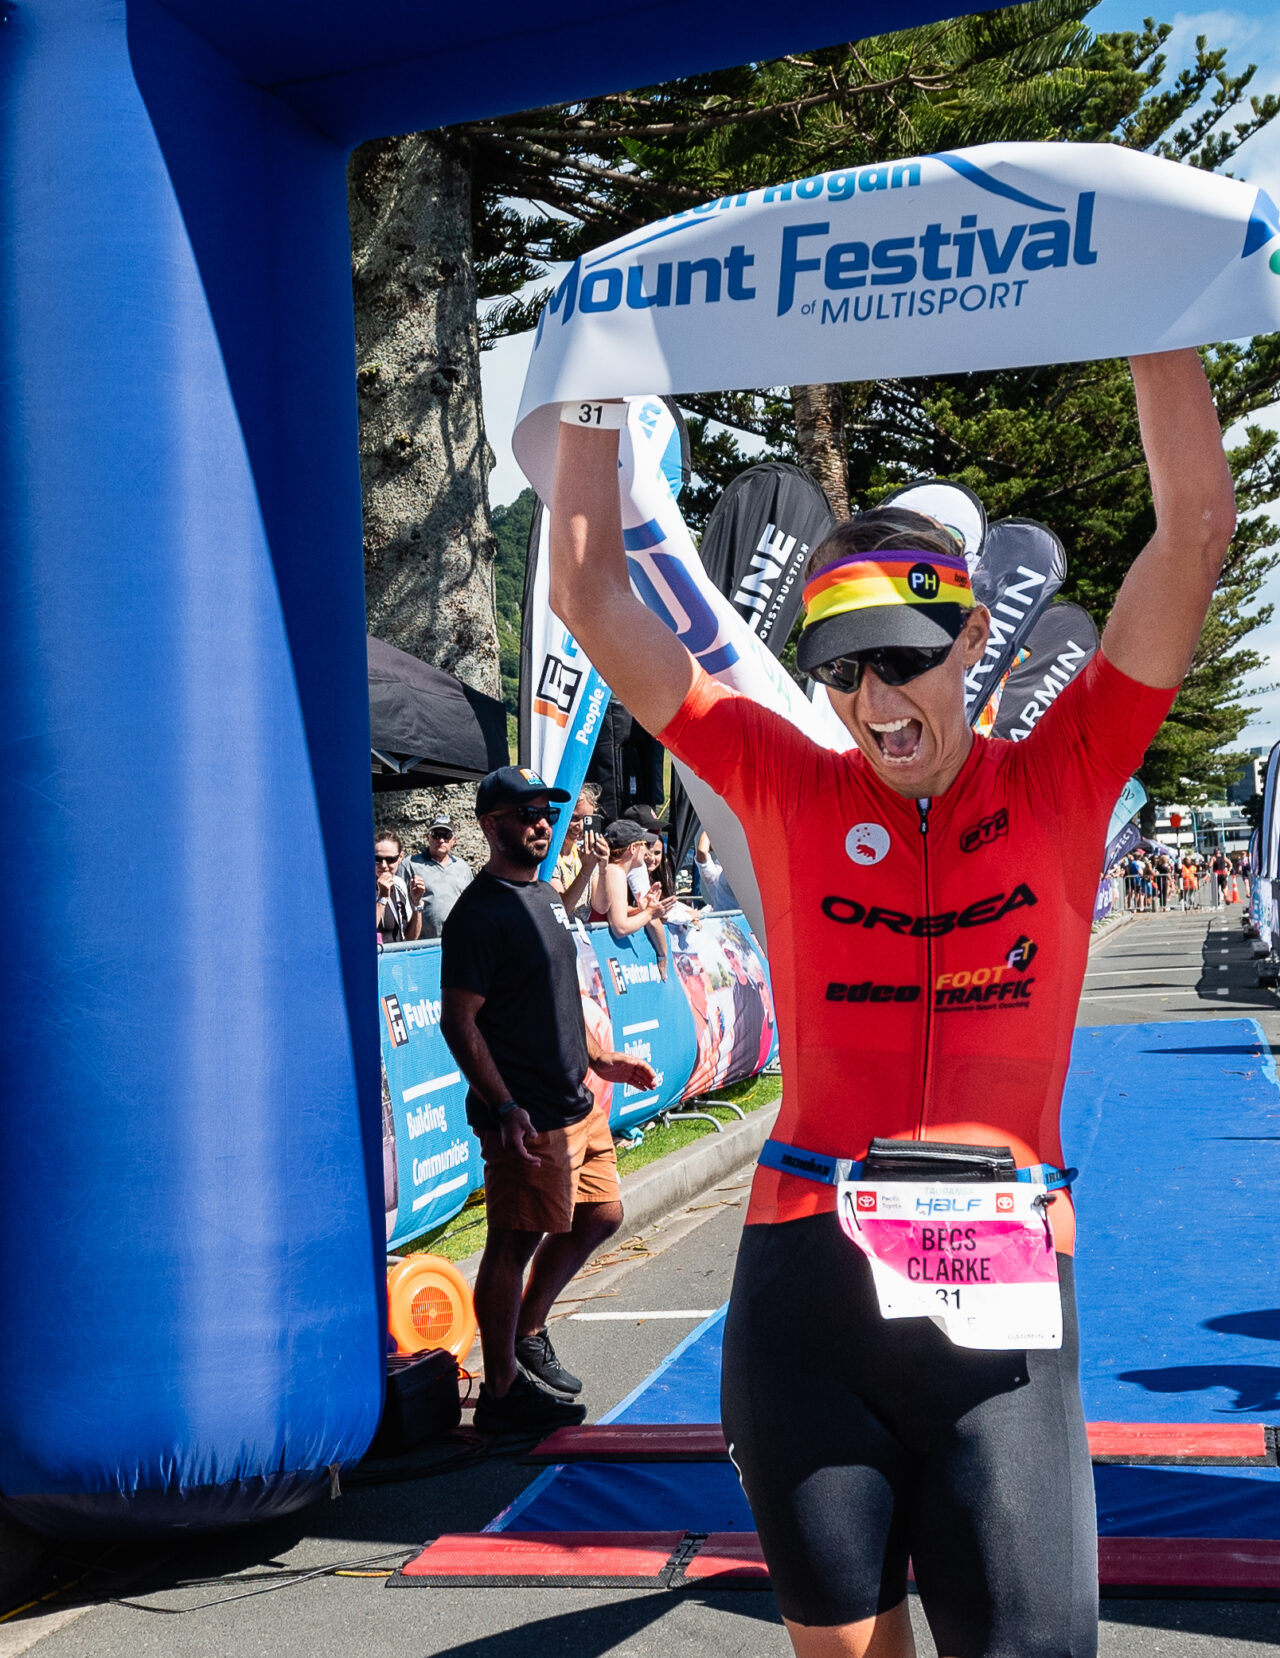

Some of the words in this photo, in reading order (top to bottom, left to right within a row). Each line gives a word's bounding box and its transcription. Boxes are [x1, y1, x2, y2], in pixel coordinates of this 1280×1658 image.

[777, 191, 1098, 317] Festival
[801, 300, 816, 316] of
[820, 279, 1028, 326] MULTISPORT
[578, 403, 603, 425] 31
[911, 572, 937, 591] PH
[575, 689, 604, 745] People
[820, 883, 1038, 938] ORBEA
[935, 965, 1008, 990] FOOT
[935, 977, 1035, 1005] TRAFFIC
[825, 980, 921, 1004] edco
[406, 1103, 448, 1140] Building
[412, 1138, 469, 1187] Communities
[922, 1227, 976, 1251] BECS
[907, 1257, 991, 1281] CLARKE
